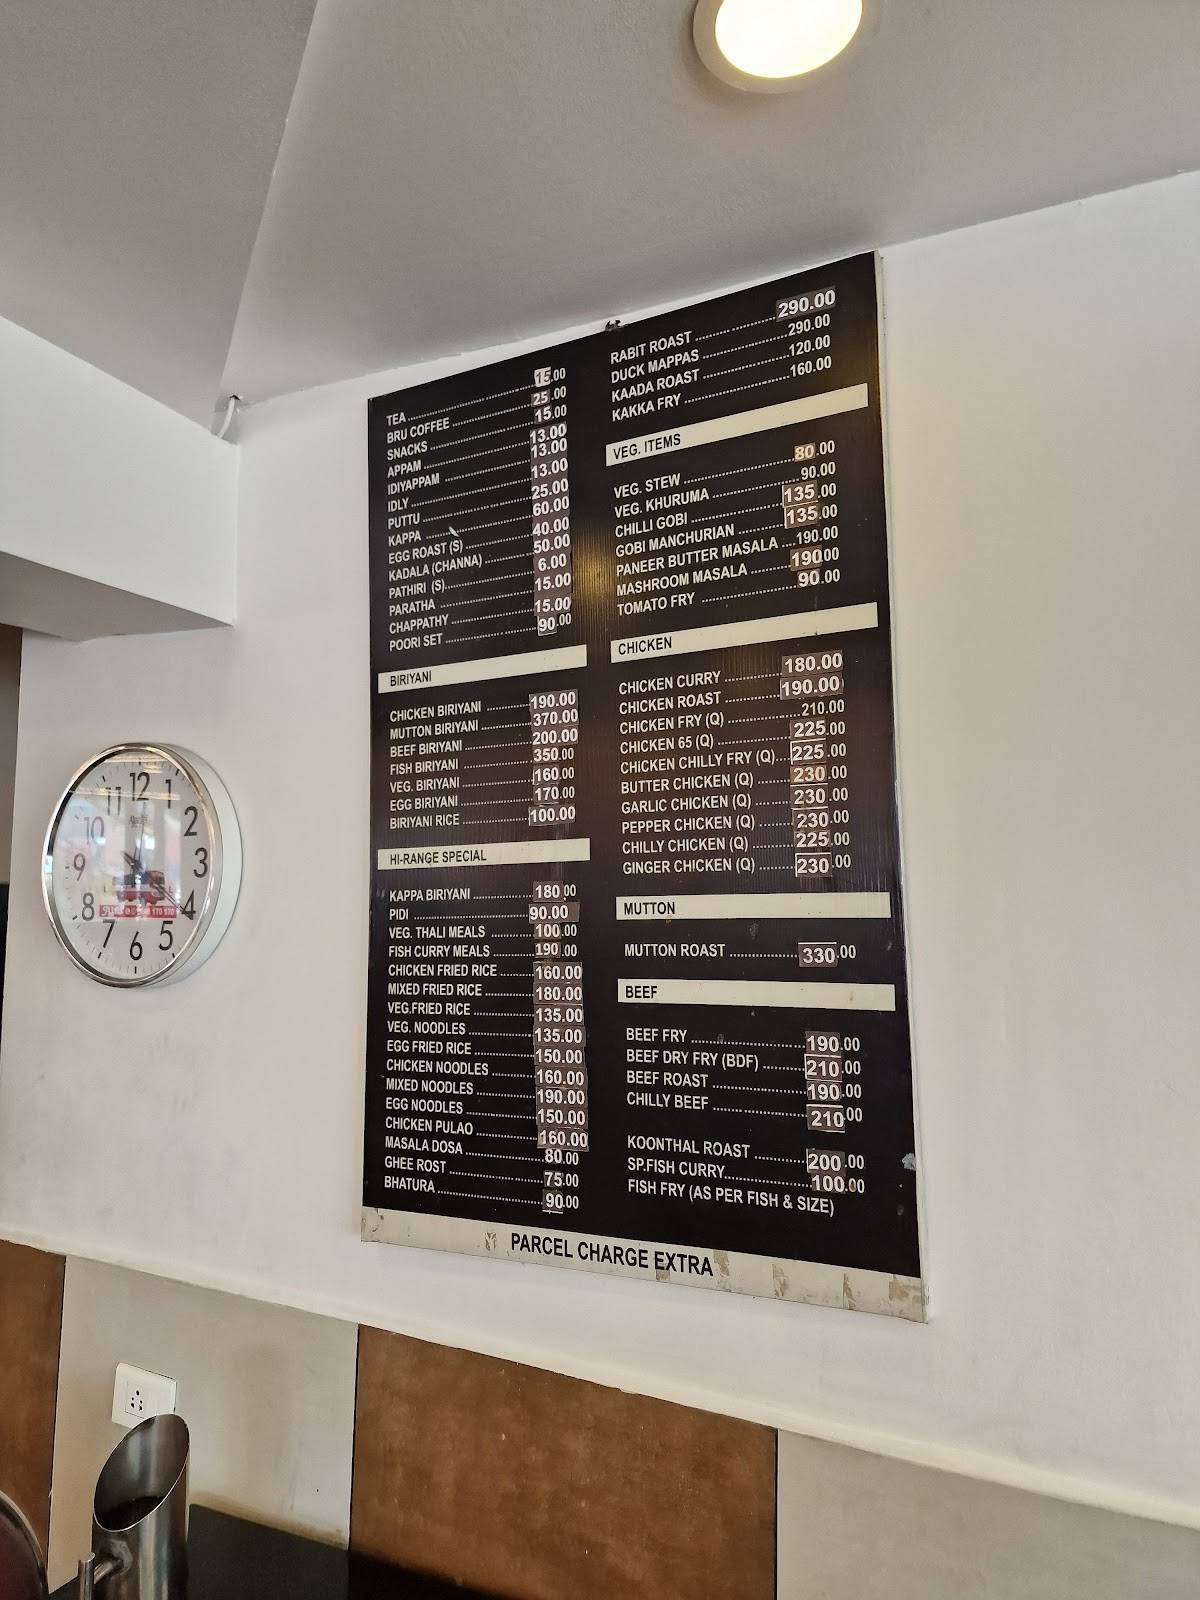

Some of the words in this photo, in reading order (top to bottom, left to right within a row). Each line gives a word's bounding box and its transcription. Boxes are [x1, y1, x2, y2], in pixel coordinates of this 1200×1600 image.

[610, 343, 646, 364] RABIT
[650, 331, 692, 353] ROAST
[778, 289, 835, 318] 290.00
[611, 364, 644, 383] DUCK
[648, 349, 699, 373] MAPPAS
[788, 313, 830, 336] 290.00
[612, 401, 655, 422] KAKKA
[658, 393, 682, 410] FRY
[790, 356, 832, 378] 160.00
[386, 412, 406, 426] TEA
[387, 426, 408, 444] BRU
[410, 418, 450, 438] COFFEE
[614, 444, 640, 460] VEG.
[644, 434, 681, 453] ITEMS
[388, 460, 422, 478] APPAM
[388, 473, 440, 494] IDIYAPPAM
[614, 482, 642, 498] VEG.
[645, 473, 681, 492] STEW
[388, 514, 420, 529] PUTTU
[532, 479, 569, 499] 25.00
[388, 530, 421, 547] KAPPA
[533, 497, 570, 516] 60.00
[615, 518, 653, 538] CHILLI
[656, 512, 688, 530] GOBI
[389, 549, 410, 564] EGG
[412, 542, 447, 560] ROAST
[450, 540, 463, 555] (S)
[532, 517, 570, 536] 40.00
[617, 558, 664, 576] PANEER
[669, 547, 718, 569] BUTTER
[722, 537, 778, 558] MASALA
[796, 526, 839, 544] 190.00
[389, 582, 426, 599] PATHIRI
[432, 579, 445, 594] (S)
[538, 554, 567, 570] 6.00
[617, 575, 689, 597] MASHROOM
[693, 563, 747, 583] MASALA
[617, 598, 667, 616] TOMATO
[671, 592, 695, 608] FRY
[798, 569, 840, 587] 90.00
[390, 615, 448, 634] CHAPPATHY
[534, 594, 571, 612] 15.00
[390, 637, 421, 652] POORI
[424, 633, 442, 648] SET
[619, 636, 672, 655] CHICKEN
[390, 671, 432, 686] BIRIYANI
[390, 705, 434, 722] CHICKEN
[438, 701, 482, 717] BIRIYANI
[531, 692, 576, 709] 190.00
[620, 716, 674, 735] CHICKEN
[678, 714, 702, 729] FRY
[705, 712, 724, 728] (Q)
[802, 700, 844, 716] 210.00
[390, 745, 416, 758] BEEF
[419, 740, 462, 756] BIRIYANI
[532, 729, 578, 745] 200.00
[679, 754, 723, 769] CHILLY
[727, 751, 752, 765] FRY
[756, 750, 775, 766] (Q)
[130, 772, 150, 801] 12
[390, 781, 413, 793] VEG.
[417, 777, 460, 792] BIRIYANI
[535, 767, 574, 782] 160.00
[621, 778, 669, 794] BUTTER
[673, 774, 731, 791] CHICKEN
[735, 772, 754, 788] (Q)
[105, 787, 121, 816] 11
[184, 806, 198, 836] 2
[390, 815, 432, 829] BIRIYANI
[436, 814, 459, 826] RICE
[531, 807, 576, 822] 100.00
[622, 819, 670, 833] PEPPER
[674, 816, 731, 832] CHICKEN
[736, 815, 755, 830] (Q)
[74, 853, 86, 881] 9
[193, 848, 208, 878] 3
[390, 852, 438, 865] HI-RANGE
[442, 850, 487, 863] SPECIAL
[623, 861, 670, 874] GINGER
[674, 858, 731, 873] CHICKEN
[736, 857, 755, 873] (Q)
[82, 892, 94, 921] 8
[389, 889, 423, 901] KAPPA
[426, 888, 470, 900] BIRIYANI
[389, 909, 408, 920] PIDI
[530, 905, 568, 920] 90.00
[624, 902, 675, 915] MUTTON
[103, 919, 115, 948] 7
[159, 921, 173, 950] 5
[389, 928, 412, 938] VEG.
[416, 926, 445, 938] THALI
[449, 926, 485, 938] MEALS
[130, 931, 142, 960] 6
[389, 946, 411, 957] FISH
[414, 945, 450, 957] CURRY
[453, 945, 490, 957] MEALS
[625, 944, 676, 957] MUTTON
[681, 944, 725, 957] ROAST
[389, 965, 434, 976] CHICKEN
[437, 965, 468, 976] FRIED
[472, 965, 497, 976] RICE
[536, 966, 582, 979] 160.00
[625, 986, 657, 998] BEEF
[446, 1003, 470, 1015] RICE
[536, 1008, 582, 1022] 135.00
[626, 1028, 659, 1041] BEEF
[663, 1029, 687, 1042] FRY
[387, 1040, 409, 1052] EGG
[412, 1041, 443, 1053] FRIED
[446, 1042, 471, 1054] RICE
[536, 1049, 582, 1063] 150.00
[626, 1049, 659, 1063] BEEF
[663, 1051, 690, 1064] DRY
[693, 1052, 718, 1066] FRY
[722, 1053, 759, 1072] (BDF)
[387, 1059, 433, 1073] CHICKEN
[436, 1061, 489, 1075] NOODLES
[537, 1070, 584, 1085] 160.00
[627, 1092, 671, 1107] CHILLY
[675, 1094, 709, 1110] BEEF
[385, 1136, 429, 1151] MASALA
[432, 1139, 463, 1154] DOSA
[627, 1135, 699, 1154] KOONTHAL
[704, 1141, 750, 1159] ROAST
[385, 1156, 414, 1170] GHEE
[417, 1159, 446, 1173] ROST
[679, 1161, 725, 1177] CURRY
[385, 1176, 435, 1193] BHATURA
[628, 1179, 656, 1194] FISH
[661, 1181, 685, 1197] FRY
[689, 1185, 711, 1203] (AS
[716, 1188, 743, 1203] PER
[747, 1191, 778, 1207] FISH
[783, 1195, 793, 1209] &
[797, 1197, 834, 1217] SIZE)
[512, 1232, 573, 1257] PARCEL
[578, 1241, 648, 1268] CHARGE
[655, 1251, 714, 1277] EXTRA
